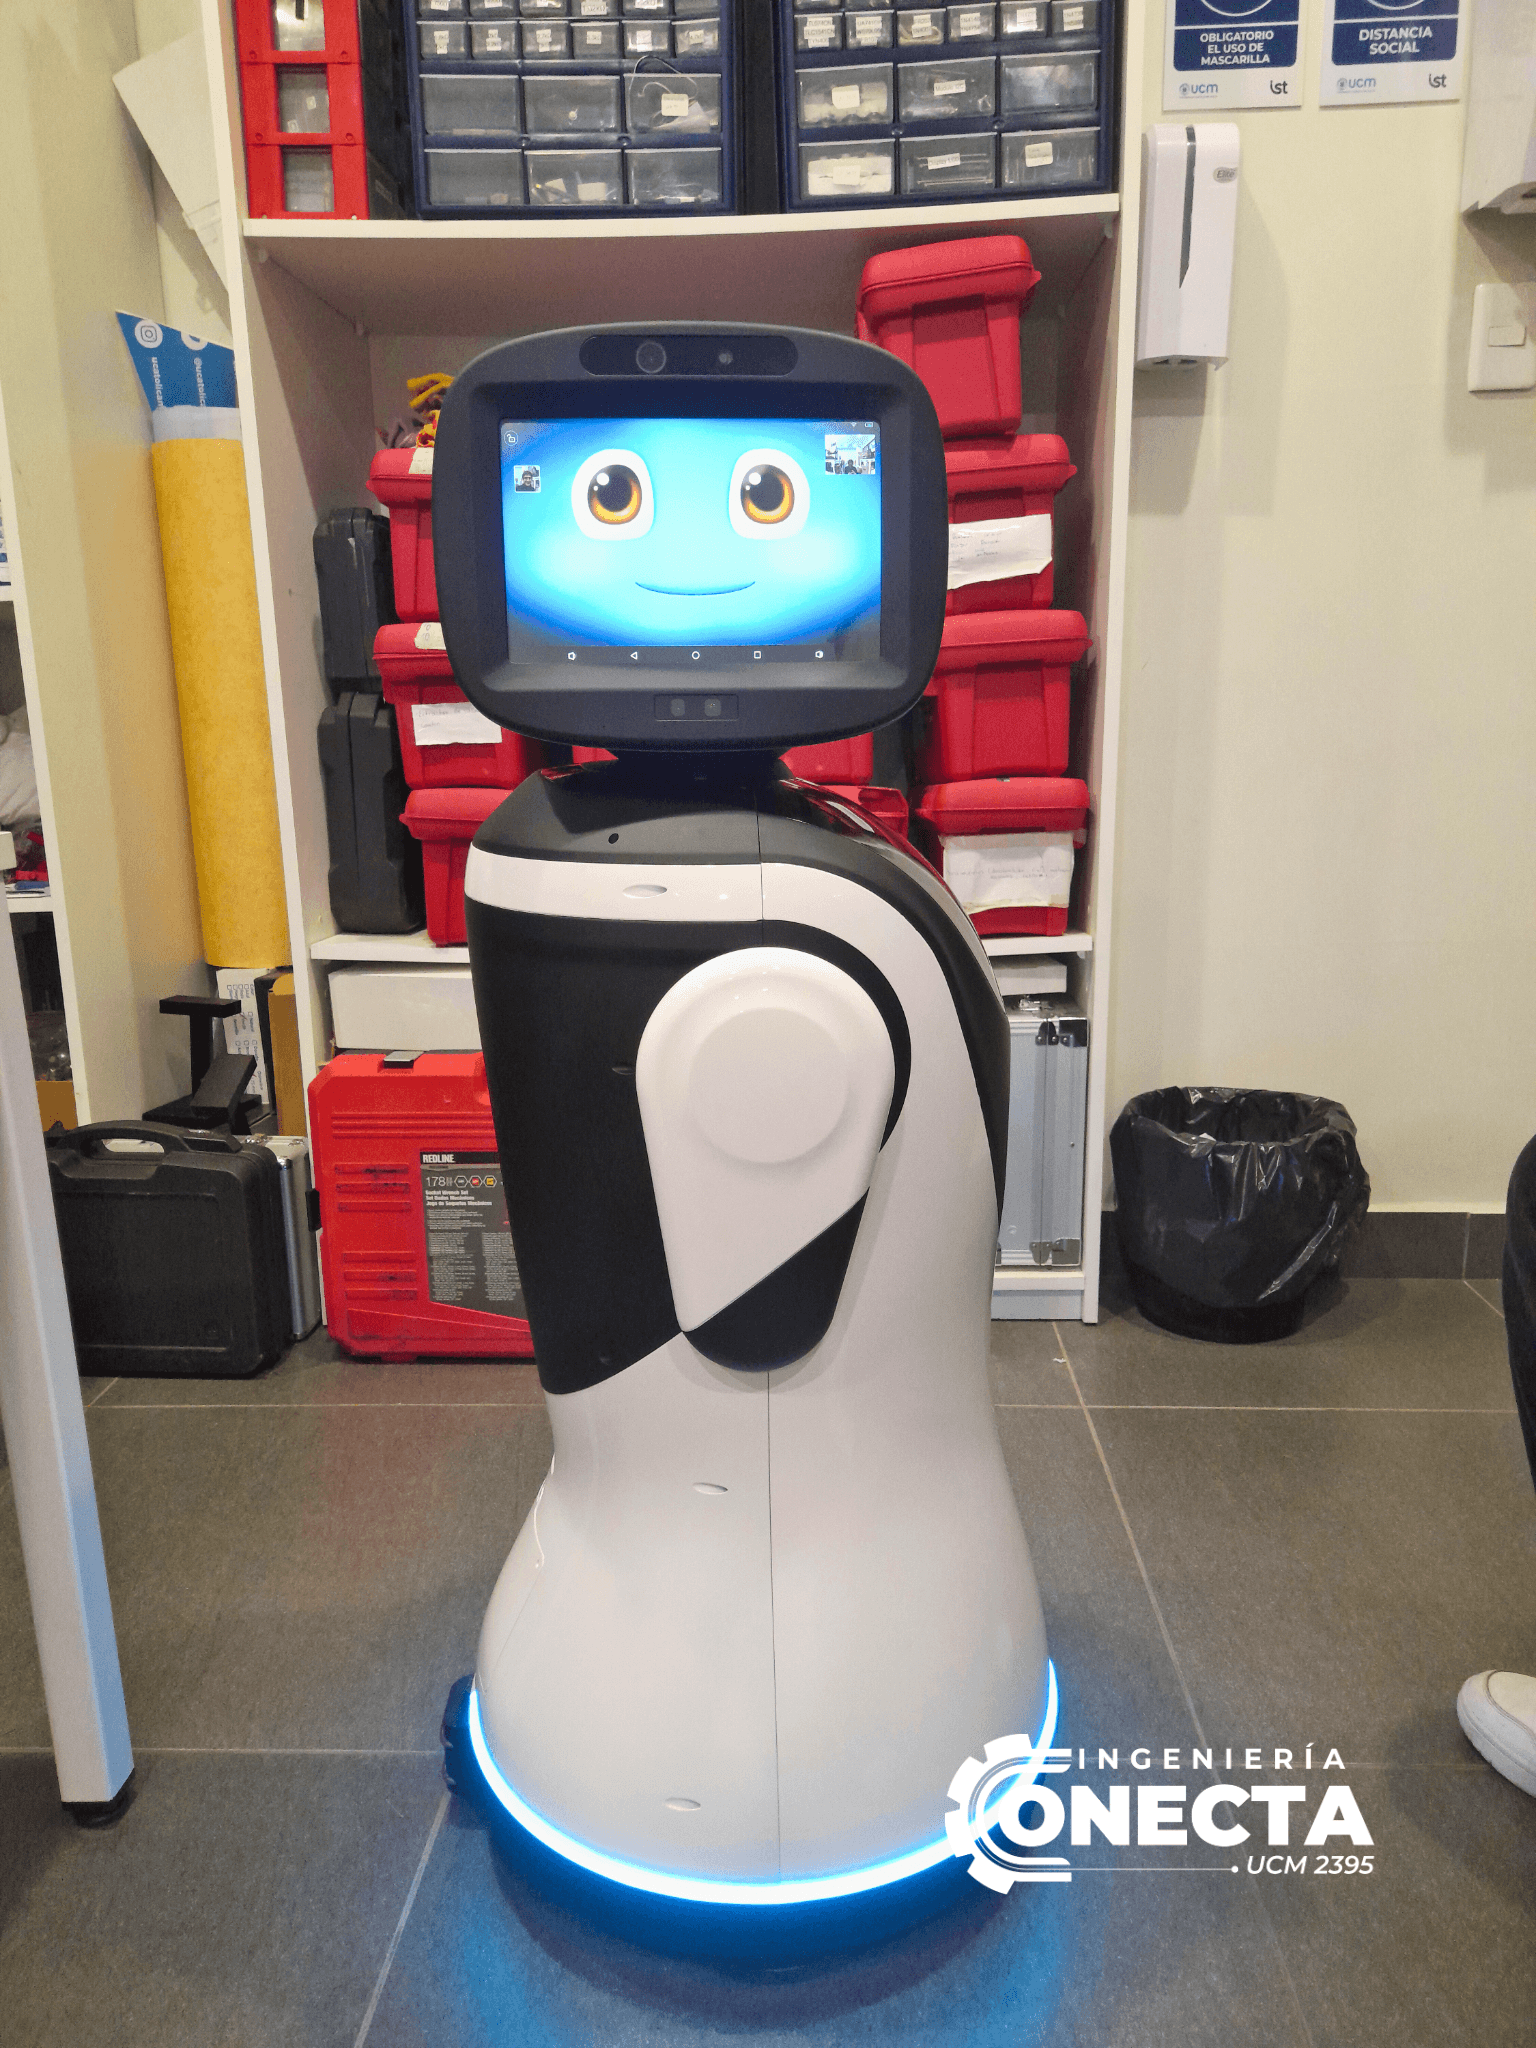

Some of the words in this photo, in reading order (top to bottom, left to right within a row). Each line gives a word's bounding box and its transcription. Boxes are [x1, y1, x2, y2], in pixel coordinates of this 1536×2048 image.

[1200, 30, 1274, 43] OBLIGATORIO
[1359, 26, 1433, 42] DISTANCIA
[1208, 44, 1220, 54] EL
[1223, 43, 1246, 54] USO
[1249, 42, 1264, 53] DE
[1369, 40, 1420, 55] SOCIAL
[1200, 53, 1271, 66] MASCARILLA
[1348, 77, 1376, 89] ucm
[1429, 73, 1447, 88] ist
[1191, 83, 1219, 94] ucm
[1270, 80, 1288, 95] ist
[422, 1154, 455, 1164] REDLINE
[425, 1176, 446, 1187] 178
